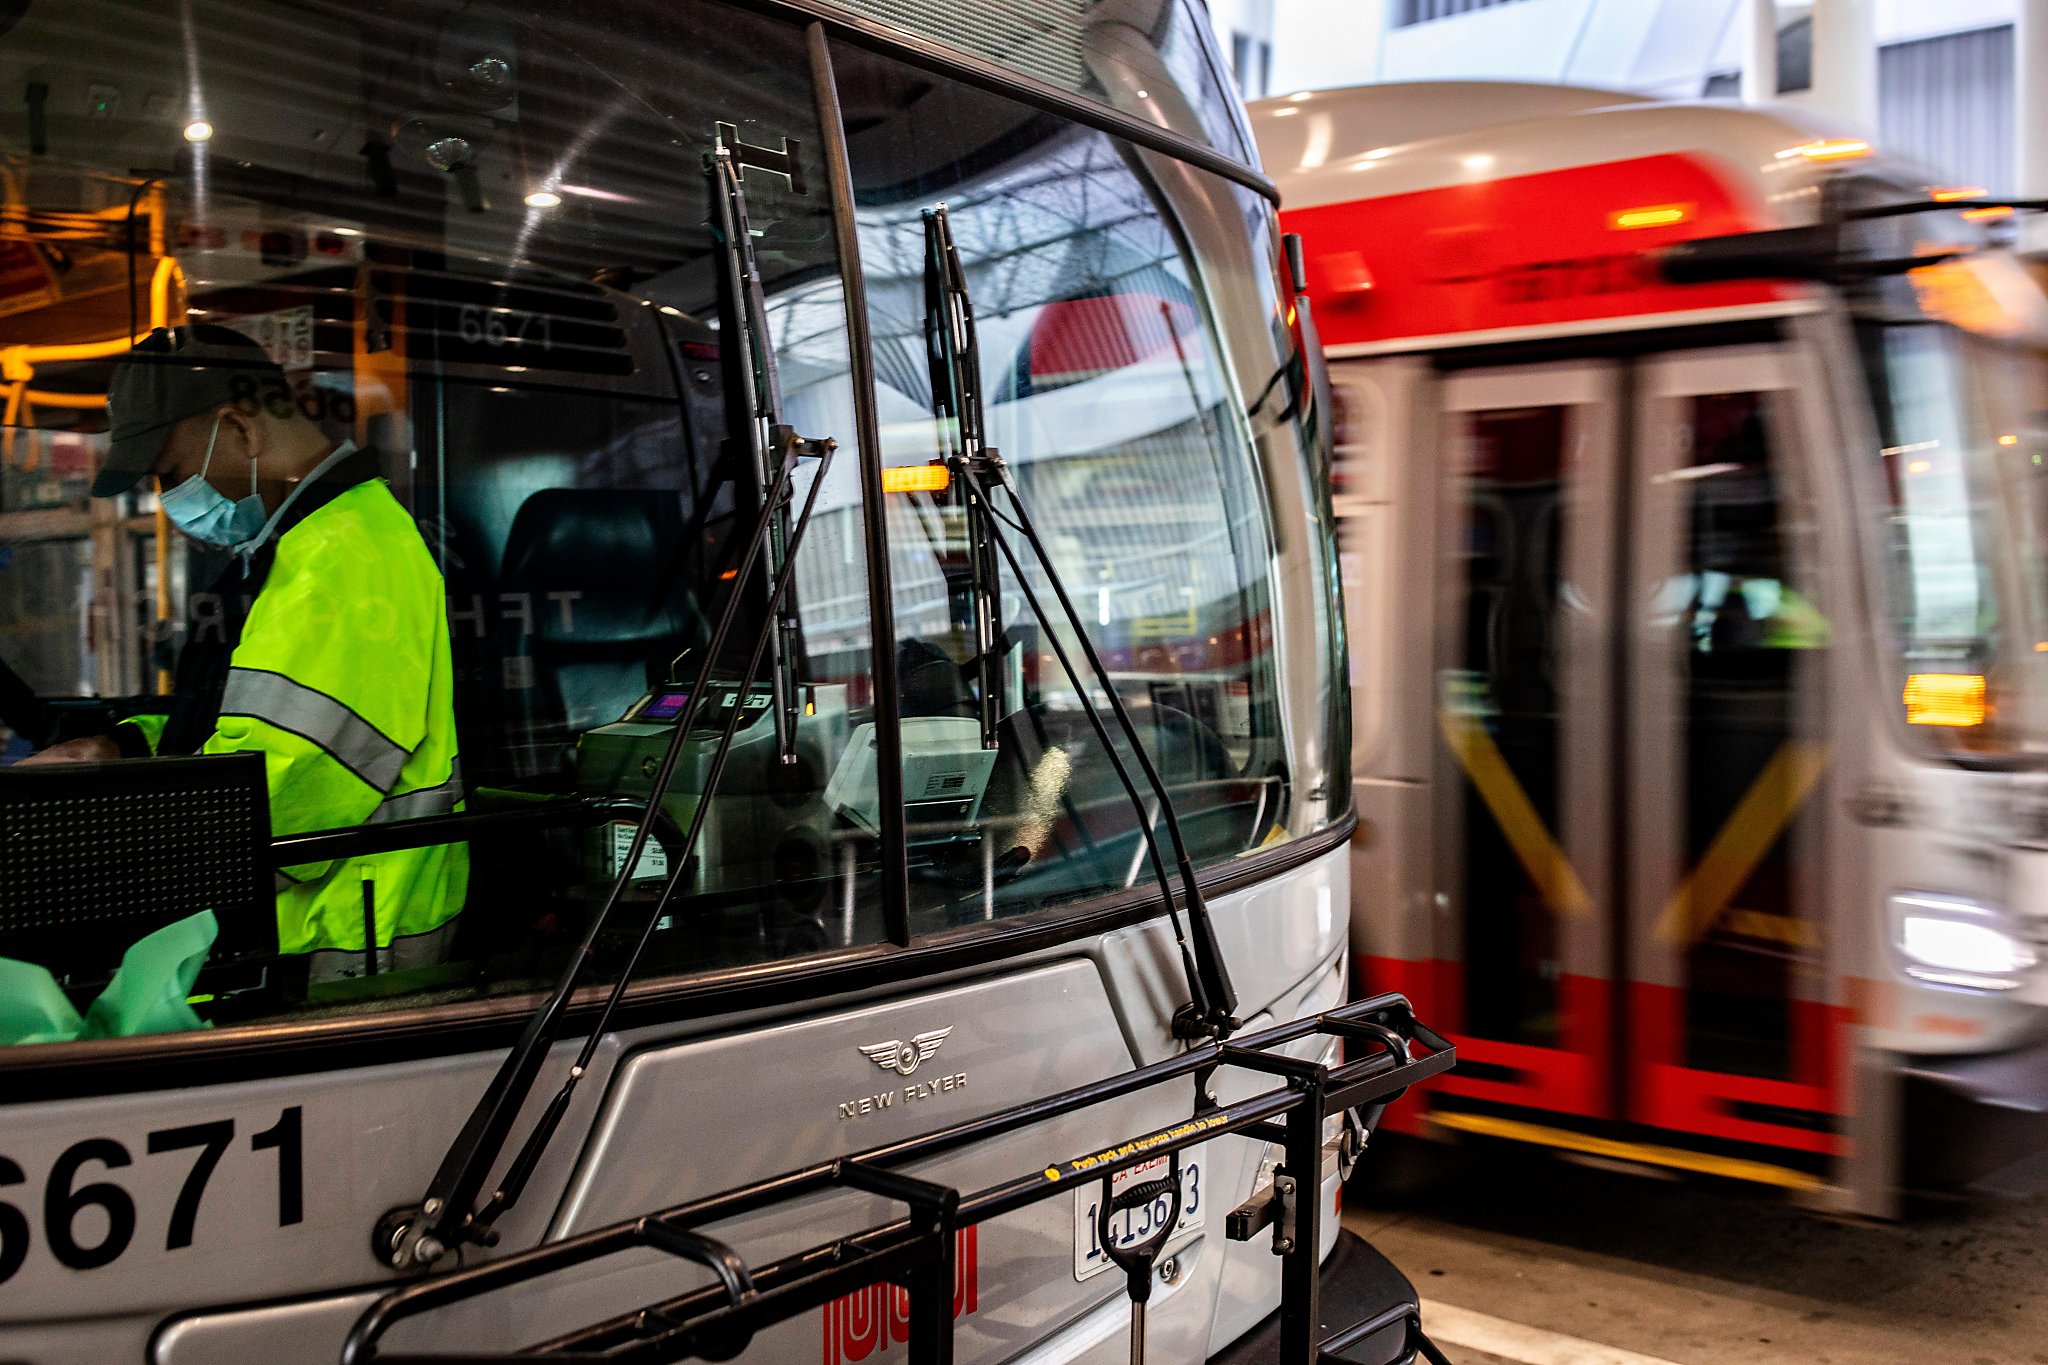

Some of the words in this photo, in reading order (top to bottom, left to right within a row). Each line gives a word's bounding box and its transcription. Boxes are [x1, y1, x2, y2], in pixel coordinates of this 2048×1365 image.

[838, 1091, 894, 1119] NEW
[904, 1072, 967, 1102] FLYER
[1071, 1156, 1099, 1171] Push
[1098, 1150, 1118, 1163] rack
[1119, 1143, 1136, 1157] and
[1136, 1132, 1169, 1151] squeeze
[1169, 1124, 1196, 1140] handle
[1197, 1120, 1208, 1131] to
[1207, 1114, 1229, 1128] lower
